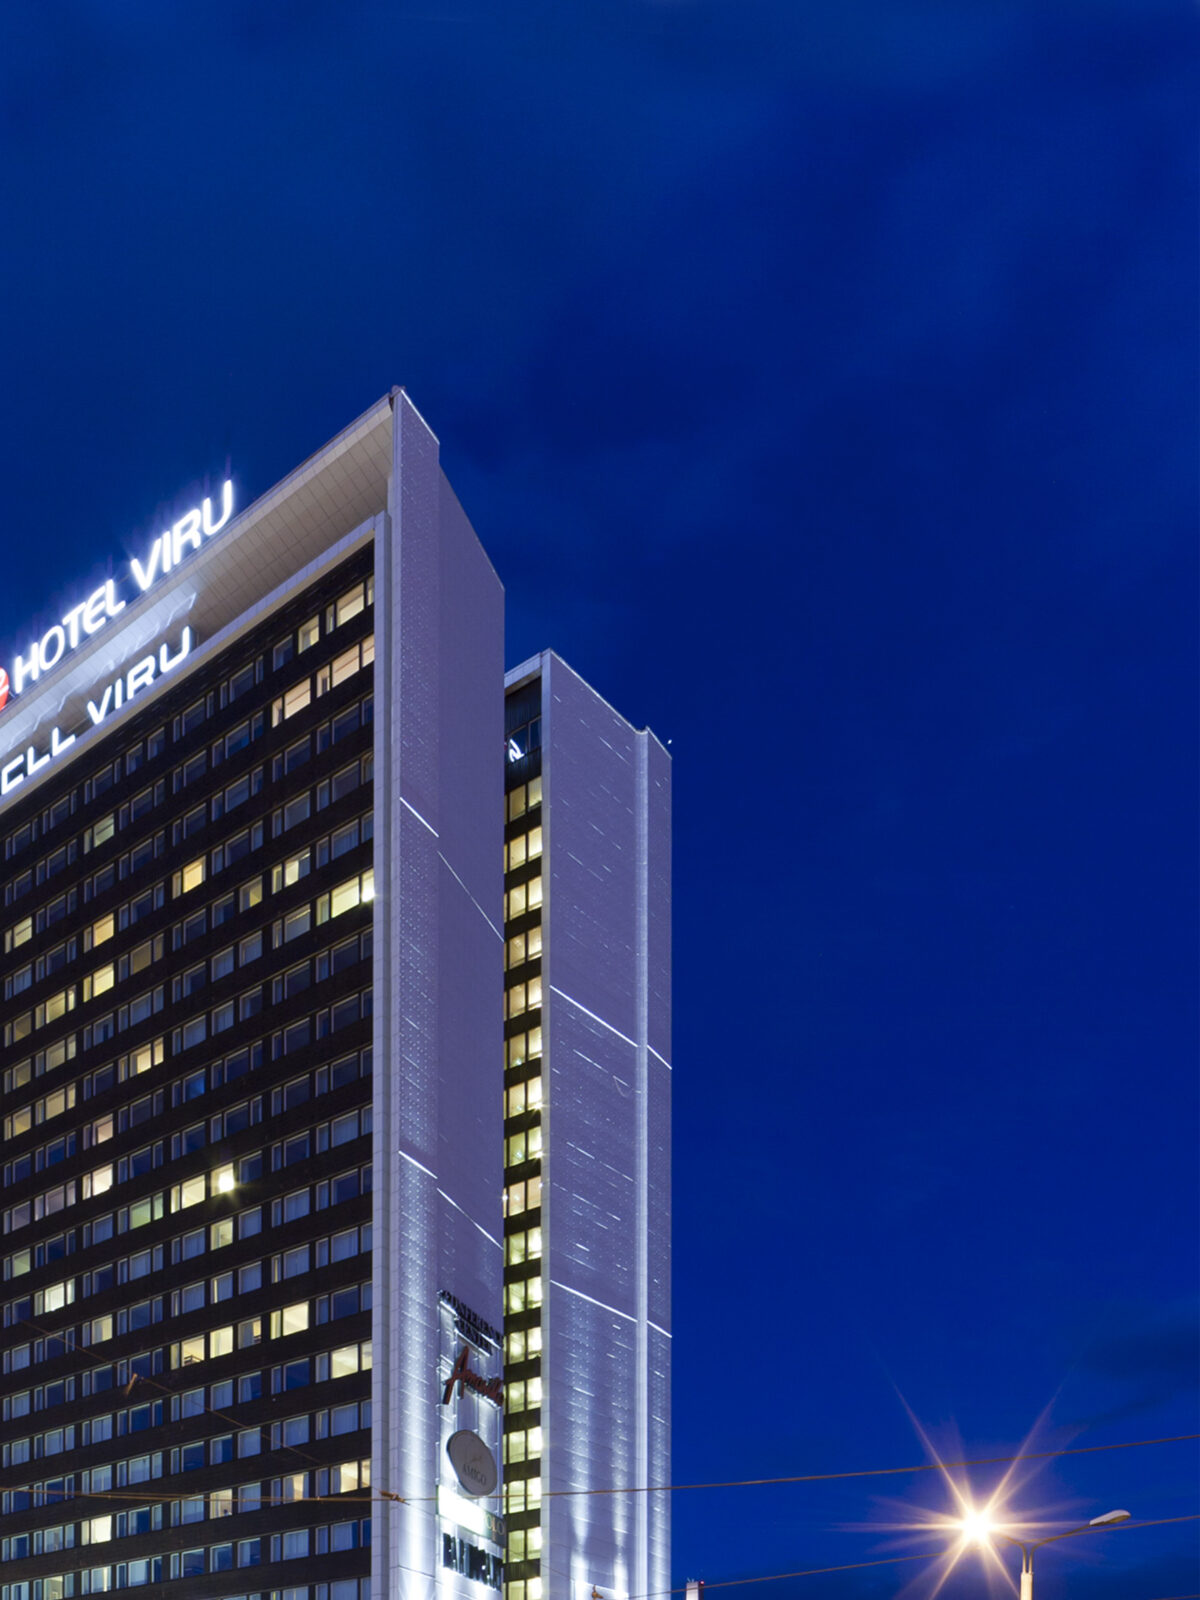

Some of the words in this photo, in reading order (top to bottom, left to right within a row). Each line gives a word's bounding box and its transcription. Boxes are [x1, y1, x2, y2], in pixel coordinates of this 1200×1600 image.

[14, 579, 126, 694] HOTEL
[130, 479, 234, 591] VIRU
[87, 626, 192, 725] VIRU
[461, 1463, 487, 1486] AMIGO
